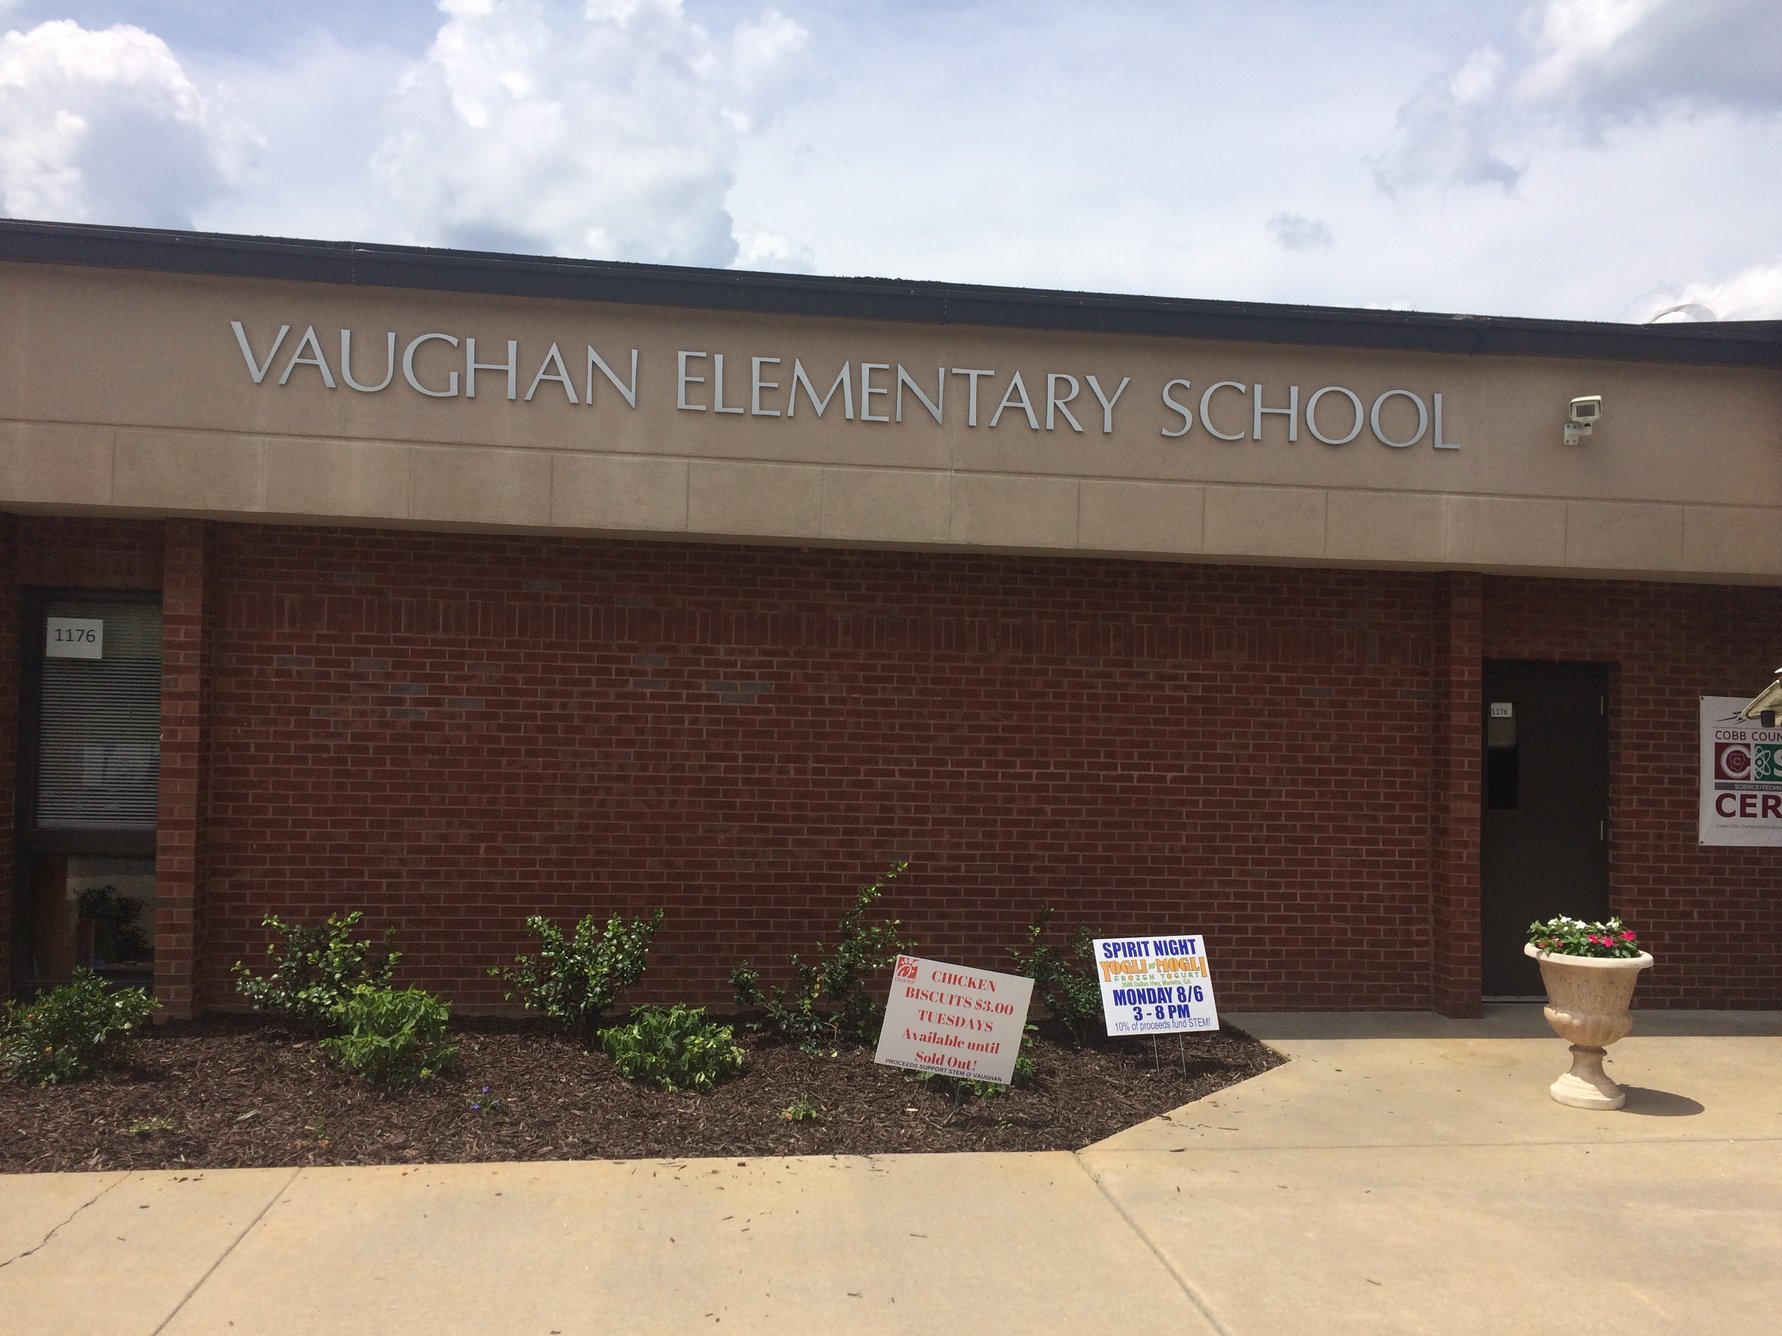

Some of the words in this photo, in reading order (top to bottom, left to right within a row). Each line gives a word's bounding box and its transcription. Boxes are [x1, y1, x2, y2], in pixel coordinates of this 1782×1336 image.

[230, 320, 639, 409] VAUGHAN
[677, 350, 1131, 434] ELEMENTARY
[1161, 378, 1461, 450] SCHOOL
[55, 628, 96, 643] 1176
[1491, 708, 1509, 716] 1176
[1715, 730, 1747, 741] COBB
[1715, 792, 1782, 819] CER
[1102, 941, 1150, 958] SPIRIT
[1153, 939, 1196, 956] NIGHT
[1099, 958, 1148, 982] YOGLI
[1155, 956, 1207, 977] MOGLI
[1114, 972, 1155, 982] FROZEN
[1161, 971, 1200, 980] YOGURT
[931, 970, 997, 993] CHICKEN
[905, 986, 972, 1009] BISCUITS
[974, 998, 1014, 1016] $3.00
[1113, 987, 1173, 1006] MONDAY
[1176, 985, 1204, 1003] 8/6
[918, 1009, 994, 1033] TUESDAYS
[1133, 1006, 1143, 1021] 3
[1155, 1005, 1165, 1020] 8
[1168, 1004, 1191, 1019] PM
[1115, 1022, 1130, 1032] 10%
[1131, 1021, 1138, 1031] of
[1140, 1020, 1170, 1032] proceeds
[1172, 1019, 1187, 1029] fund
[901, 1028, 965, 1050] Available
[967, 1041, 1001, 1055] until
[885, 1058, 918, 1069] PROCEEDS
[919, 1063, 948, 1074] SUPPORT
[949, 1068, 965, 1077] STEM
[965, 1071, 972, 1079] @
[973, 1073, 1003, 1083] VAUGHAN
[915, 1050, 945, 1067] Sold
[947, 1055, 978, 1072] Out!
